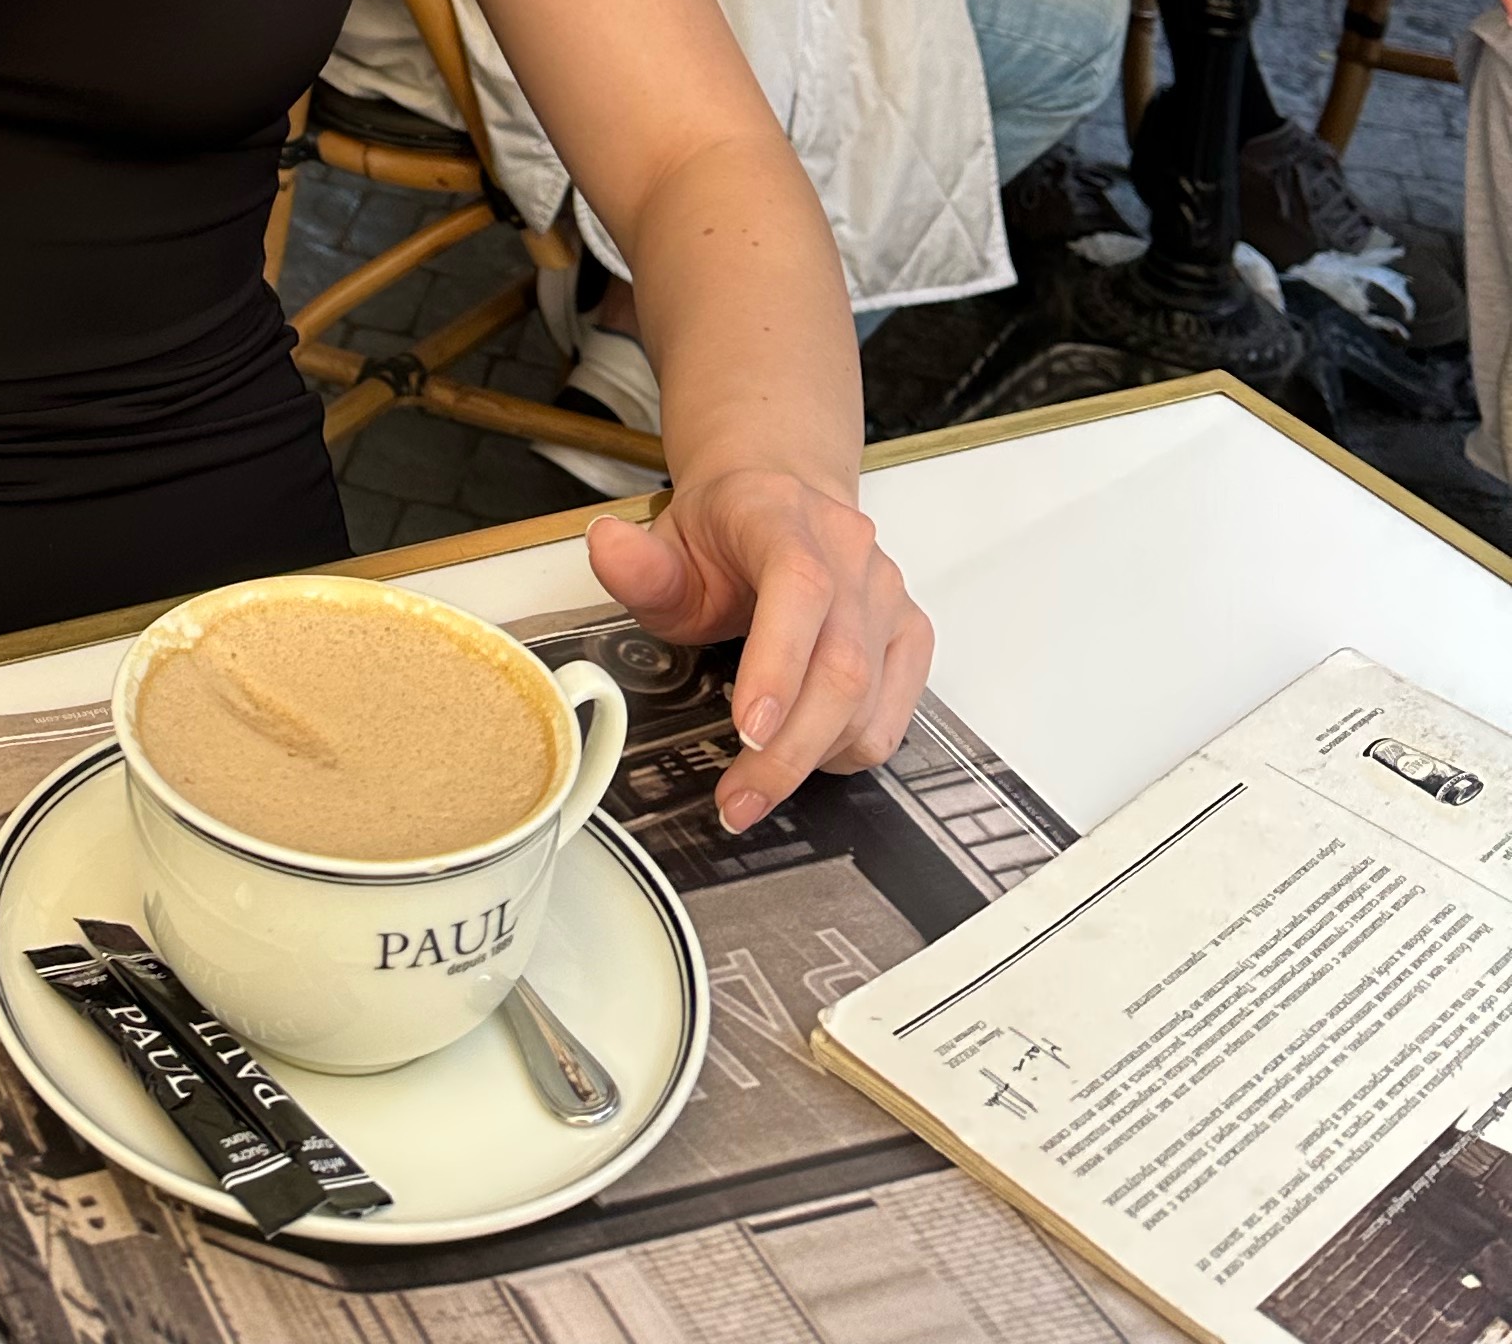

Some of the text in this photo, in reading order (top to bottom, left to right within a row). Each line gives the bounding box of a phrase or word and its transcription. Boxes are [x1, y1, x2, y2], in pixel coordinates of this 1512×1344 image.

[1245, 896, 1274, 918] PAUL
[376, 899, 519, 972] PAUL
[446, 952, 490, 977] depuis
[105, 1003, 204, 1100] PAUL
[187, 1009, 291, 1110] PAUL
[219, 1130, 260, 1149] blanc
[301, 1135, 335, 1152] sugar
[228, 1143, 271, 1164] Sucre
[308, 1156, 347, 1173] white
